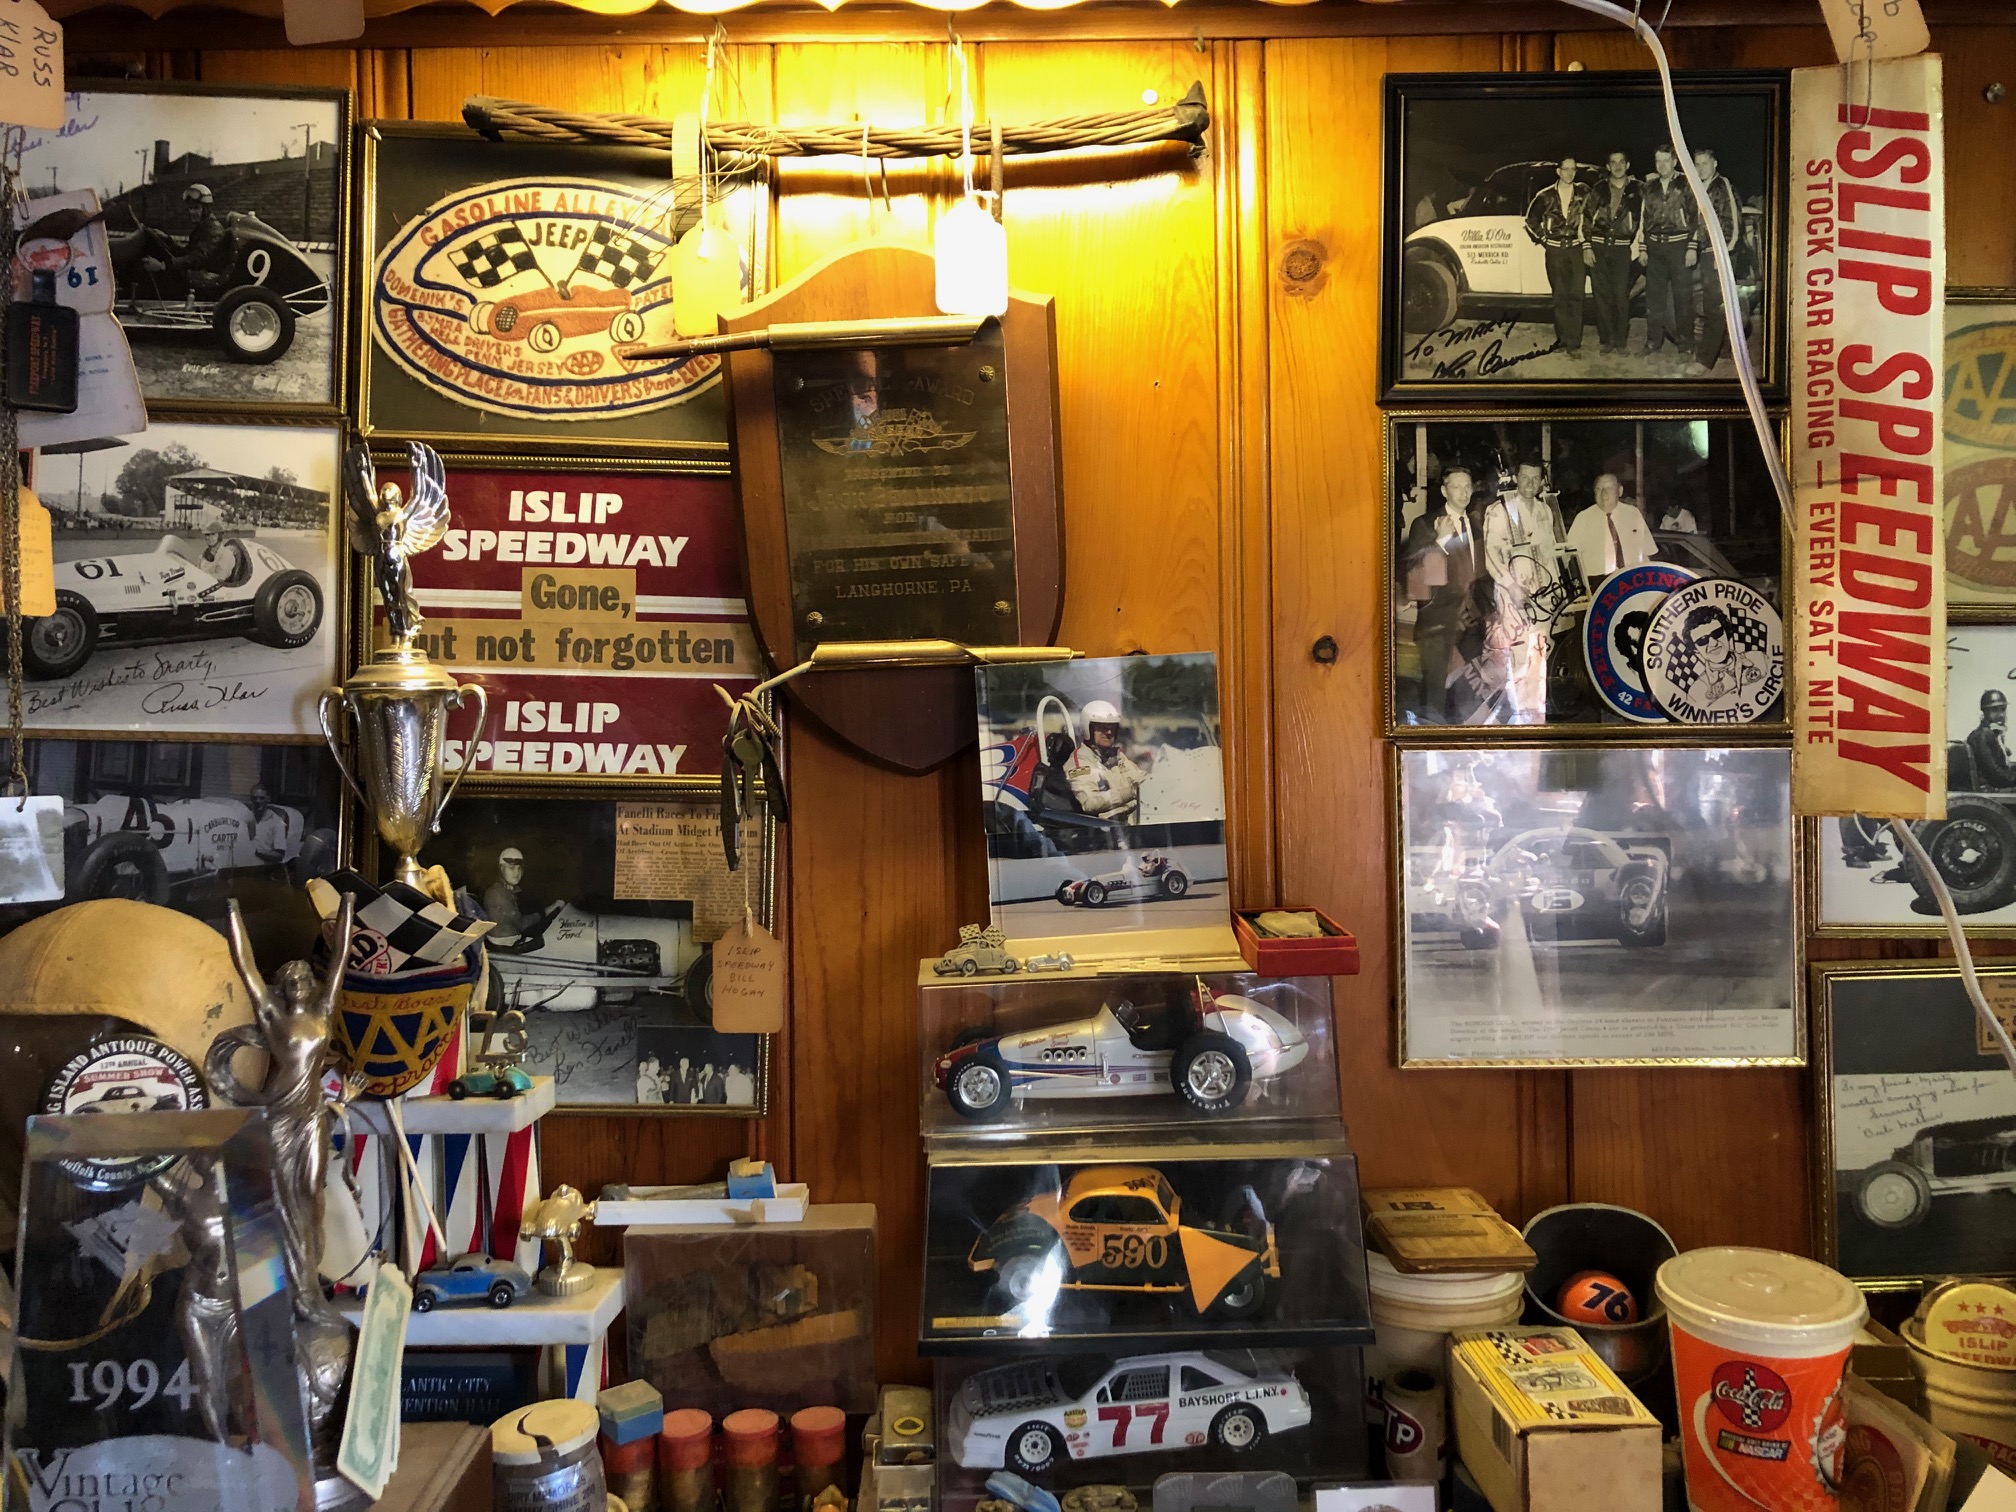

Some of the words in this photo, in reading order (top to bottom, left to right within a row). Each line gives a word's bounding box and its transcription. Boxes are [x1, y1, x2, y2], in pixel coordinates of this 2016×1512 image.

[33, 26, 57, 87] RUSS
[420, 191, 542, 247] GASOLINE
[554, 191, 635, 220] ALLEY
[1806, 159, 1834, 257] STOCK
[1836, 103, 1932, 316] ISLIP
[529, 222, 588, 250] JEEP
[246, 249, 272, 287] 9
[385, 269, 465, 311] DOMENIK'S
[1806, 268, 1834, 327] CAR
[464, 335, 523, 358] DRIVERS
[464, 348, 503, 368] PENN
[507, 359, 566, 376] JERSEY
[451, 366, 507, 396] PLACE
[524, 385, 563, 404] FANS
[576, 380, 643, 404] DRIVERS
[1806, 337, 1835, 448] RACING
[508, 490, 623, 524] ISLIP
[443, 529, 689, 567] SPEEDWAY
[1810, 501, 1835, 588] EVERY
[74, 558, 124, 580] 61
[1837, 344, 1934, 793] SPEEDWAY
[530, 573, 632, 619] Gone,
[1646, 586, 1708, 670] SOUTHERN
[1714, 583, 1764, 615] PRIDE
[1808, 600, 1834, 667] SAT.
[414, 626, 457, 661] ut
[476, 628, 536, 663] not
[555, 628, 735, 671] forgotten
[1593, 614, 1614, 690] PETTY
[1617, 690, 1633, 705] 42
[1634, 696, 1656, 711] FA
[1668, 693, 1755, 723] WINNER'S
[1755, 644, 1784, 707] CIRCLE
[505, 700, 621, 733] ISLIP
[1808, 680, 1834, 744] NITE
[443, 739, 688, 774] SPEEDWAY
[204, 817, 241, 833] CARBURETOR
[617, 806, 654, 819] Fanelli
[656, 806, 685, 820] Races
[689, 807, 700, 820] To
[211, 832, 239, 843] CARTER
[618, 824, 629, 836] At
[632, 824, 673, 836] Stadium
[677, 824, 712, 841] Midget
[557, 929, 582, 942] Ford
[717, 959, 774, 974] SPEEDWAY
[729, 973, 755, 984] BILL
[721, 984, 765, 997] HOGAN
[48, 1053, 90, 1098] ISLAND
[90, 1039, 156, 1059] ANTIQUE
[157, 1047, 197, 1086] POWER
[188, 1086, 204, 1111] ASS
[83, 1070, 131, 1082] SUMMER
[133, 1068, 164, 1079] SHOW
[117, 1058, 148, 1068] ANNUAL
[59, 1158, 95, 1179] Suffolk
[1102, 1233, 1168, 1269] 590
[1583, 1281, 1630, 1323] 76
[1958, 1336, 2009, 1351] ISLIP
[67, 1358, 200, 1412] 1994
[1178, 1391, 1241, 1408] BAYSHORE
[1097, 1402, 1170, 1448] 77
[1385, 1409, 1415, 1445] TP
[1738, 1442, 1784, 1459] NASCAR
[16, 1448, 184, 1499] Vintage
